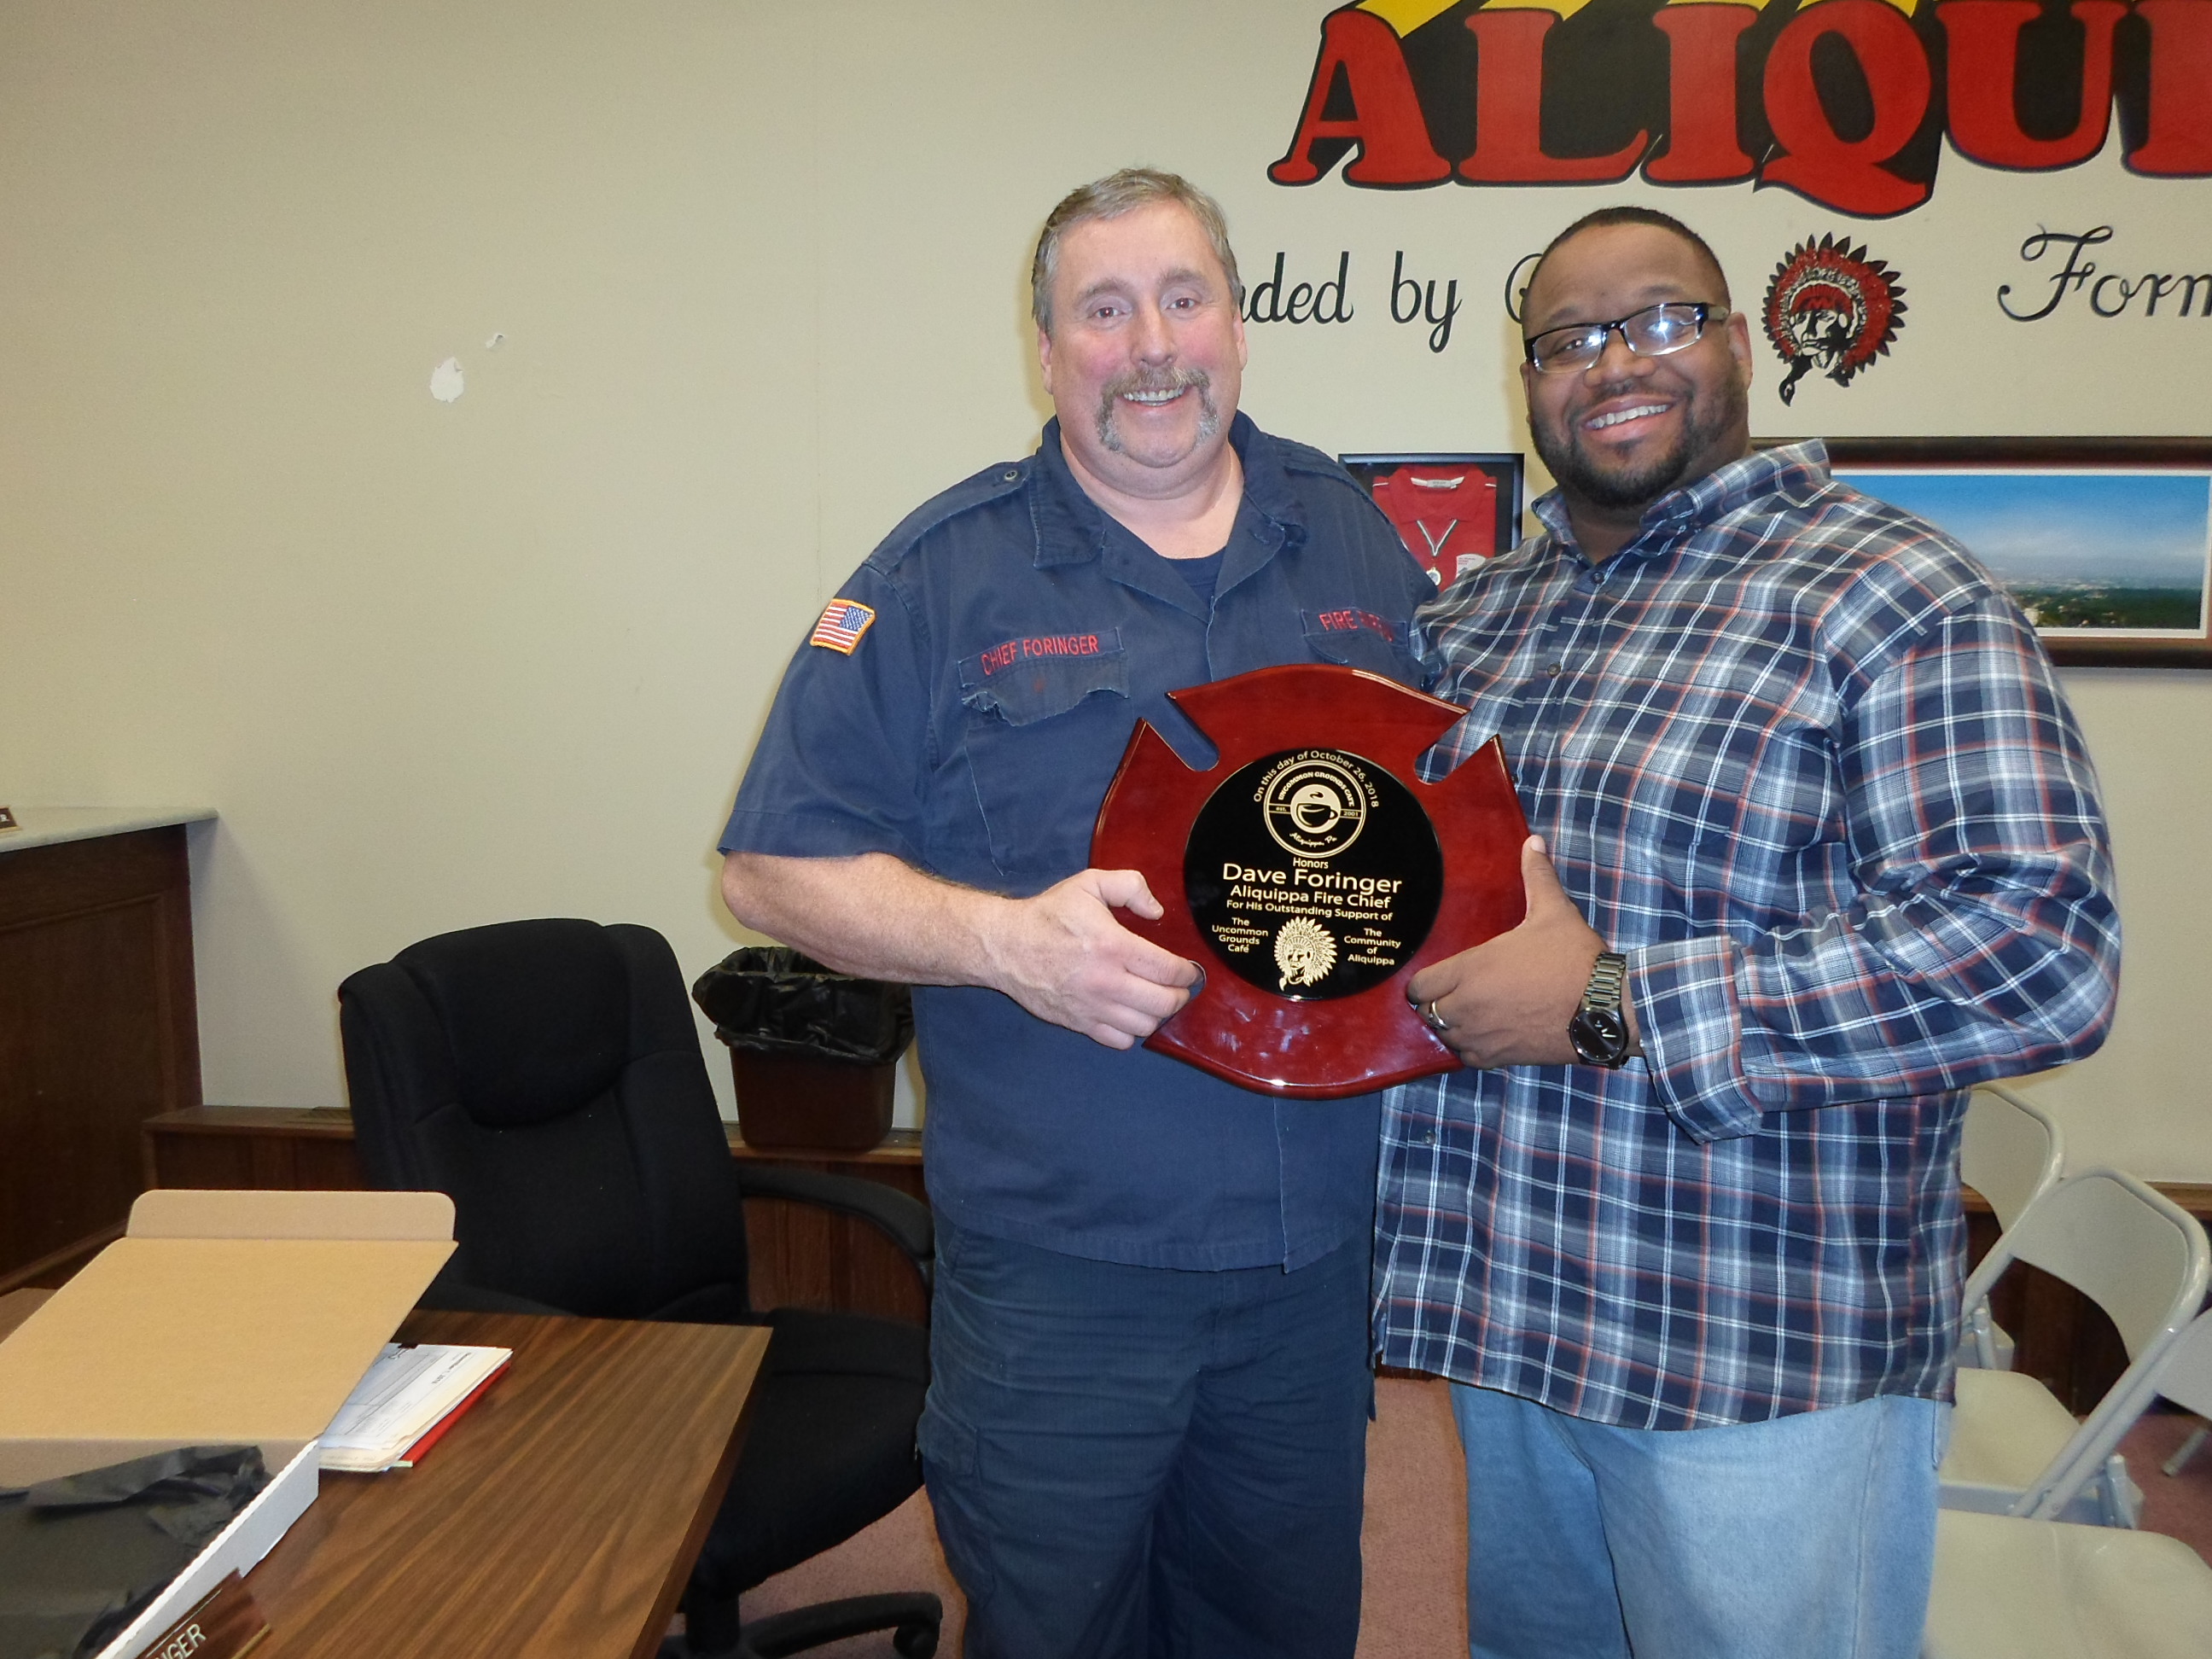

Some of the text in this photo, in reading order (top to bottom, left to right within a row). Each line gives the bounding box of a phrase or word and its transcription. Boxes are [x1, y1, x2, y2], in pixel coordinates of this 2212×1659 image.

[1390, 250, 1463, 353] by
[1318, 610, 1359, 631] FIRE
[981, 634, 1099, 676] CHIEF FORINGER
[1254, 750, 1379, 807] On this day of October 26, 2018
[1278, 771, 1313, 800] UNCOMMON
[1314, 771, 1348, 790] GROUNDS
[1293, 857, 1329, 870] Honors
[1223, 863, 1402, 895] Dave Foringer
[1230, 884, 1391, 909] Aliquippa Fire Chief
[1226, 899, 1394, 921] For His Outstanding Support of
[1211, 924, 1269, 937] Uncommon
[1231, 917, 1250, 927] The
[1219, 934, 1261, 945] Grounds
[1364, 928, 1382, 937] The
[1227, 943, 1249, 953] Café
[1343, 936, 1401, 949] Community
[1348, 953, 1395, 966] Aliquippa
